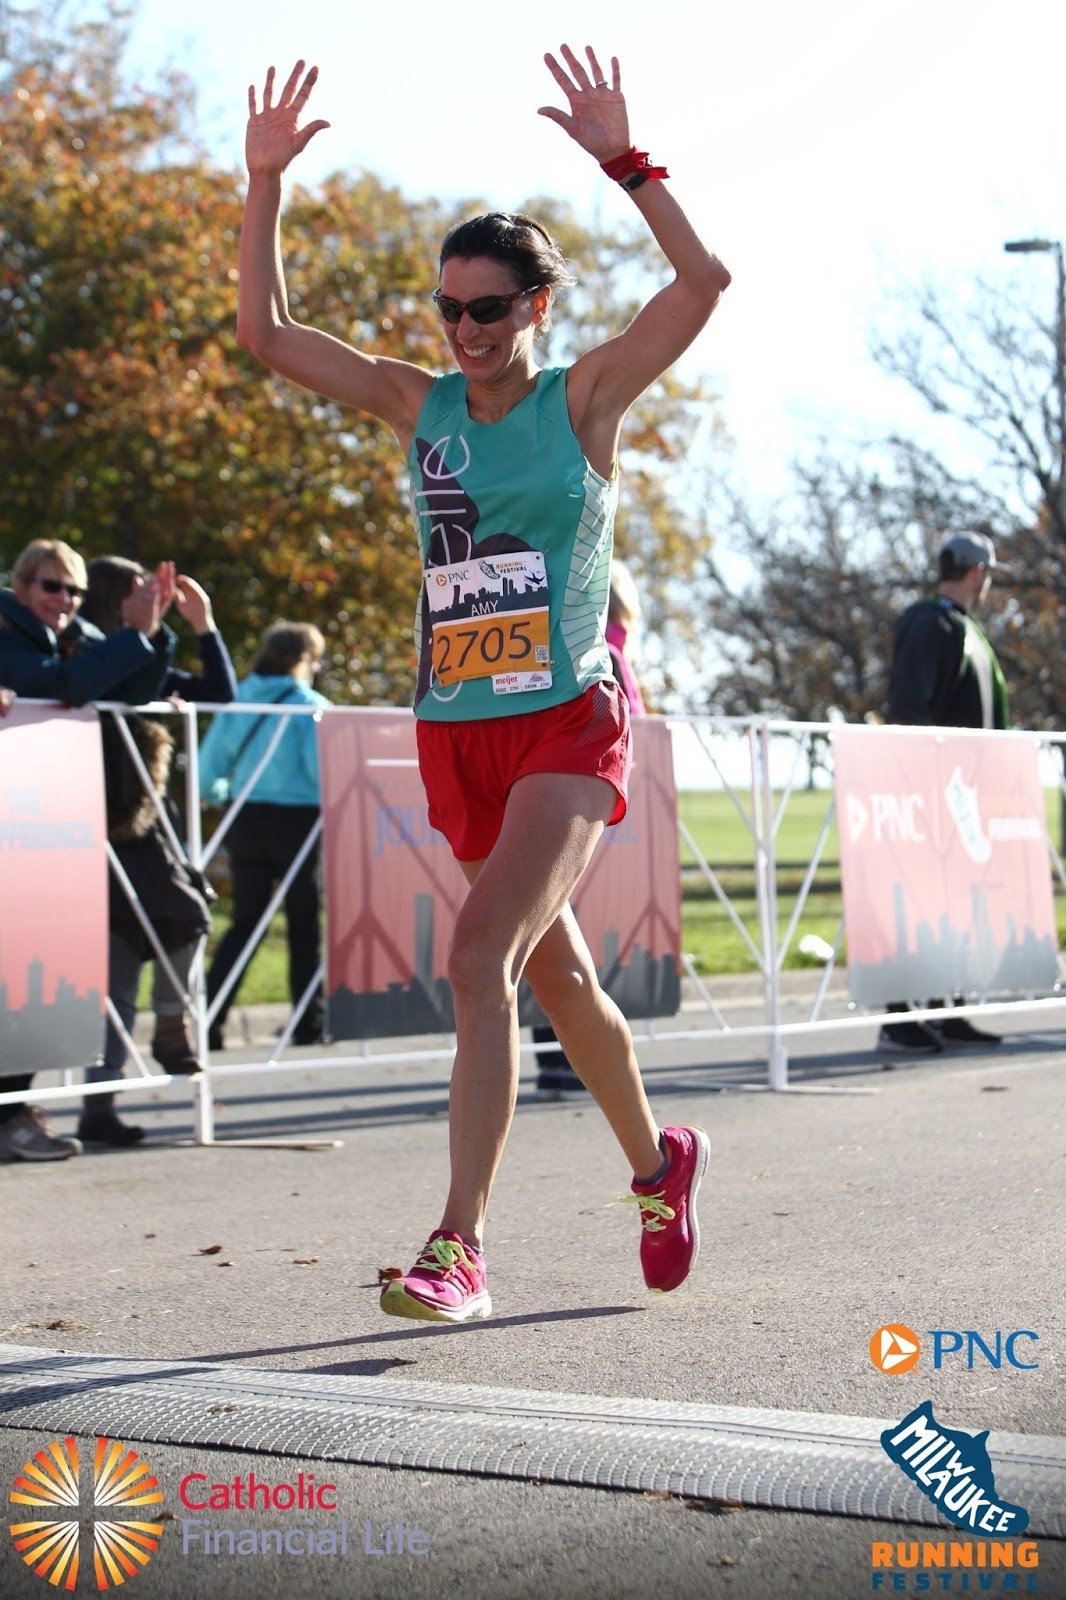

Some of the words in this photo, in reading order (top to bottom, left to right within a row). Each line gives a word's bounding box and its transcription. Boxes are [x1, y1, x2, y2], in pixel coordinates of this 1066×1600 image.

[496, 561, 524, 569] RUNNING
[500, 566, 527, 574] FESTIVAL
[448, 570, 471, 583] PNC
[471, 600, 499, 616] AMY
[436, 621, 532, 675] 2705
[496, 675, 518, 685] meijer
[868, 793, 925, 843] PNC
